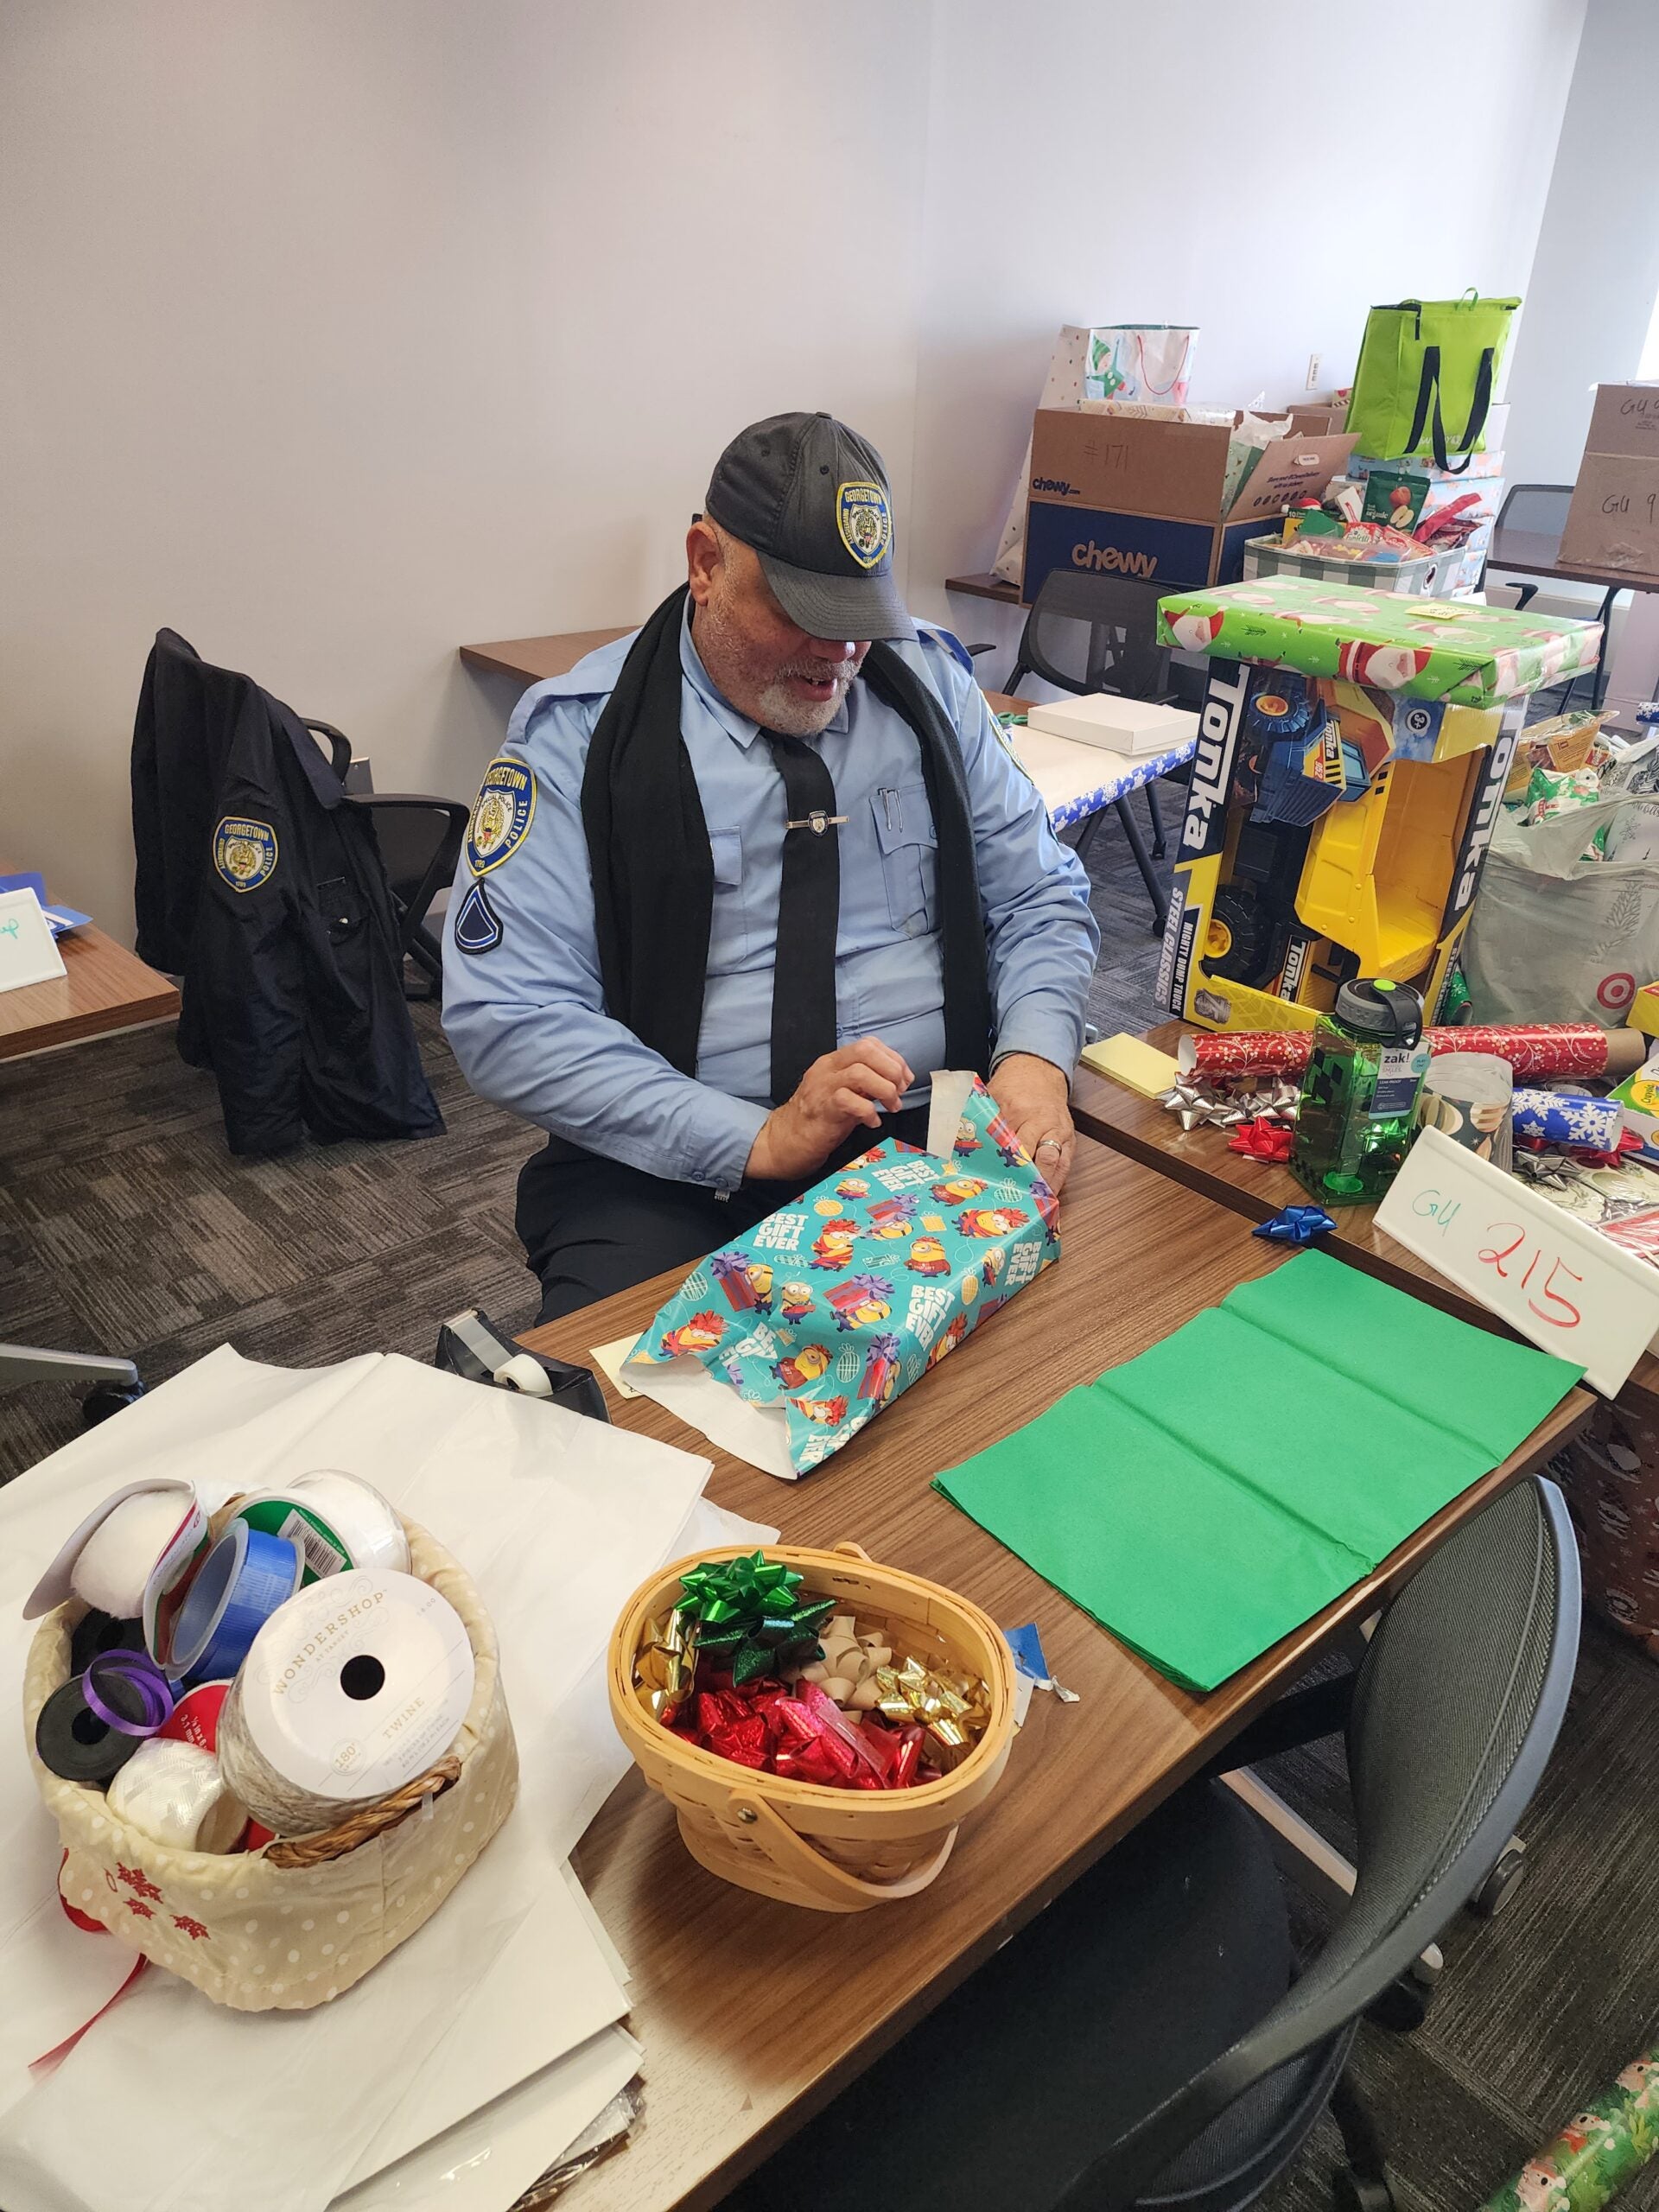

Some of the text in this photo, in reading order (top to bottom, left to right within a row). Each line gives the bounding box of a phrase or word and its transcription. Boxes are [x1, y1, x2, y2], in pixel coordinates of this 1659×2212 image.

[1071, 540, 1158, 578] chewy
[1183, 664, 1250, 850] Tonka
[225, 823, 270, 842] GEORGETOWN
[504, 800, 529, 849] POLICE
[260, 847, 274, 877] POLICE
[1155, 887, 1183, 1006] STEEL CLASSICS
[1172, 922, 1193, 1012] MIGHTY DUMP TRUCK
[1384, 1052, 1410, 1064] zak!
[1641, 1084, 1655, 1103] Crayola
[871, 1169, 906, 1192] EVER
[889, 1166, 925, 1186] GIFT
[906, 1160, 941, 1182] BEST
[758, 1223, 805, 1239] GIFT
[763, 1212, 810, 1226] BEST
[753, 1234, 799, 1251] EVER
[1005, 1243, 1024, 1287] EVER
[1015, 1243, 1033, 1284] GIFT
[1026, 1242, 1042, 1281] BEST
[1478, 1222, 1583, 1328] 215
[908, 1298, 947, 1332] GIFT
[912, 1284, 956, 1312] BEST
[905, 1312, 934, 1351] EVER
[273, 1591, 384, 1696] WONDERSHOP
[382, 1697, 425, 1738] TWINE
